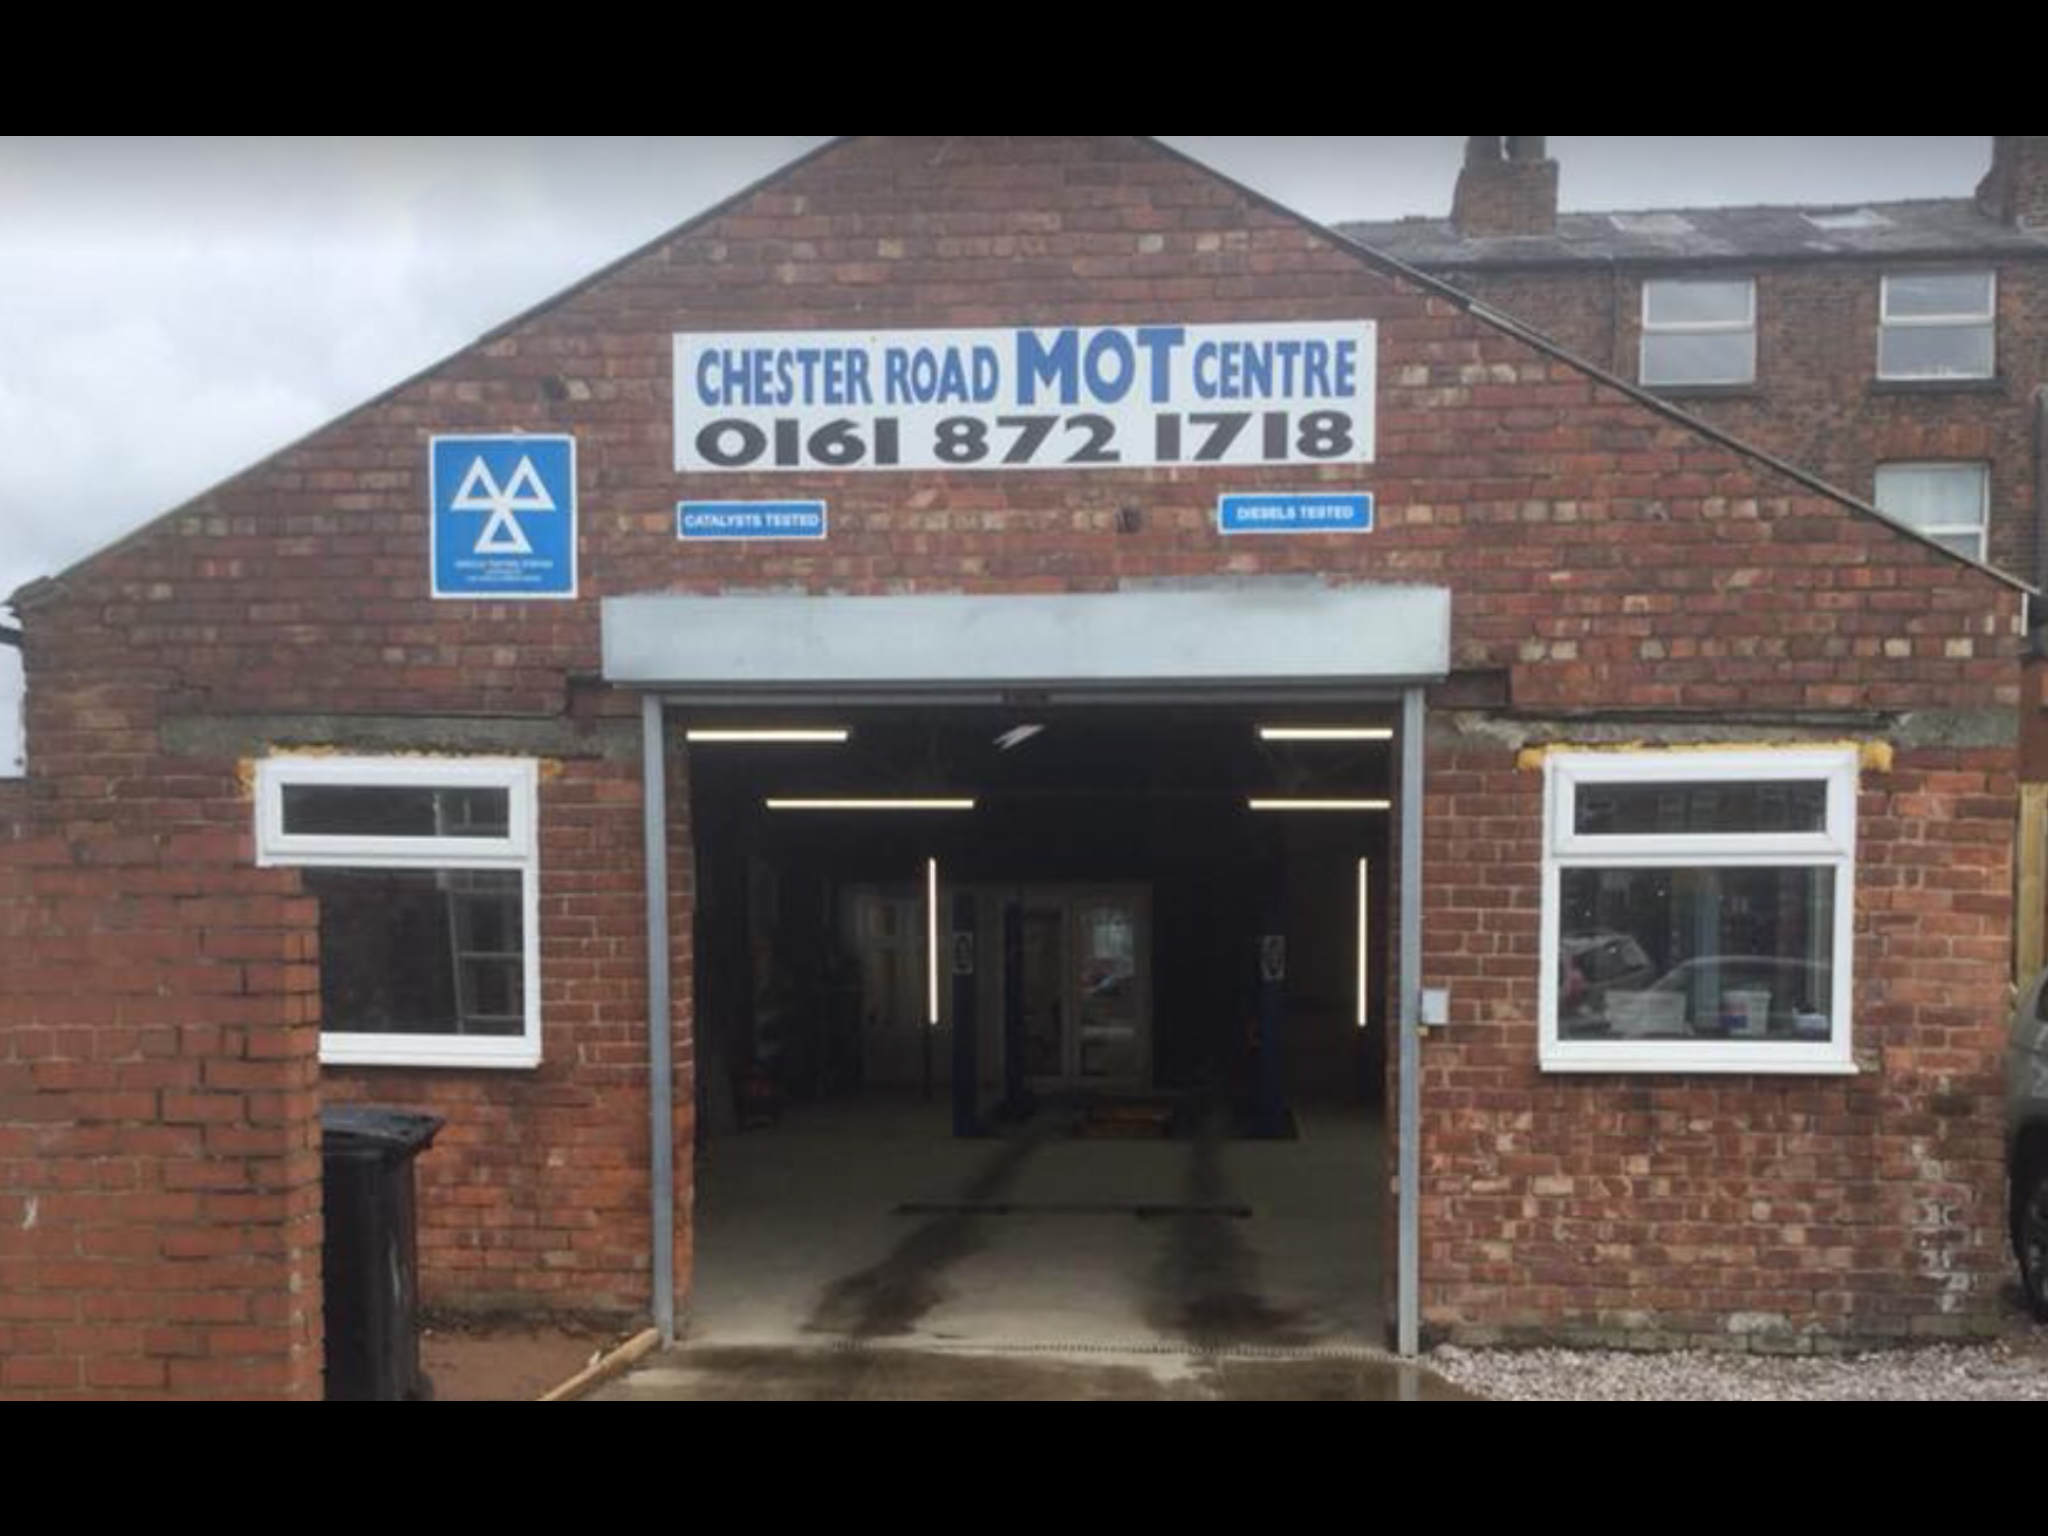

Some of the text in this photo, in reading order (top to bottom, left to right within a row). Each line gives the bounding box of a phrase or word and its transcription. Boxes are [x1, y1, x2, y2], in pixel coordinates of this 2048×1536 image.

[696, 327, 1356, 407] CHESTER ROAD MOT CENTRE
[695, 410, 1353, 467] 0161 872 1718
[684, 513, 821, 527] CATALYSTS TESTED
[1237, 505, 1354, 519] DIESELS TESTED
